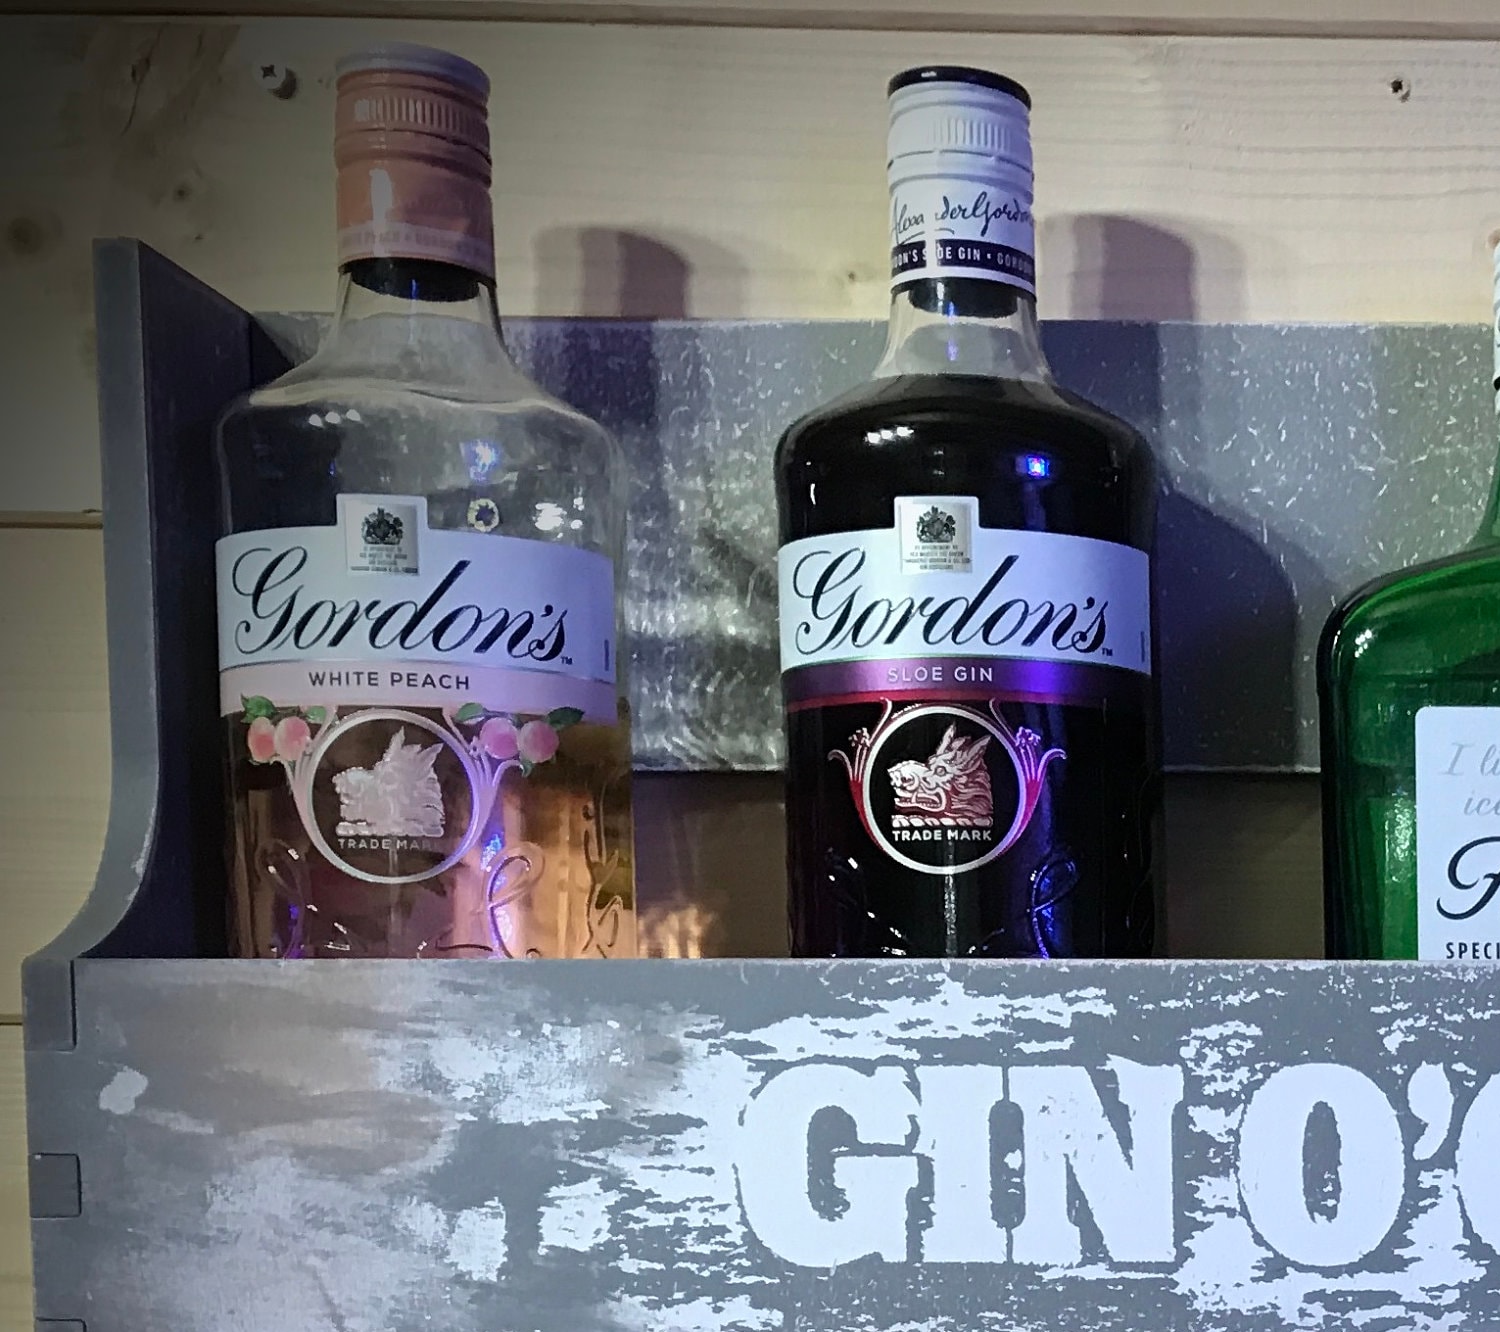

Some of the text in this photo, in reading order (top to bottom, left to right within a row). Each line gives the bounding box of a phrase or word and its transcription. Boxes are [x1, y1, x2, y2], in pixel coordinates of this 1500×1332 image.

[958, 247, 981, 261] GIN
[232, 546, 568, 661] Gordon's
[792, 547, 1108, 656] Gordon's
[308, 671, 471, 691] WHITE PEACH
[887, 665, 993, 683] SLOE GIN
[1439, 742, 1473, 776] I
[337, 838, 391, 850] TRADE
[892, 829, 992, 842] TRADE MARK
[734, 1062, 1184, 1268] GIN
